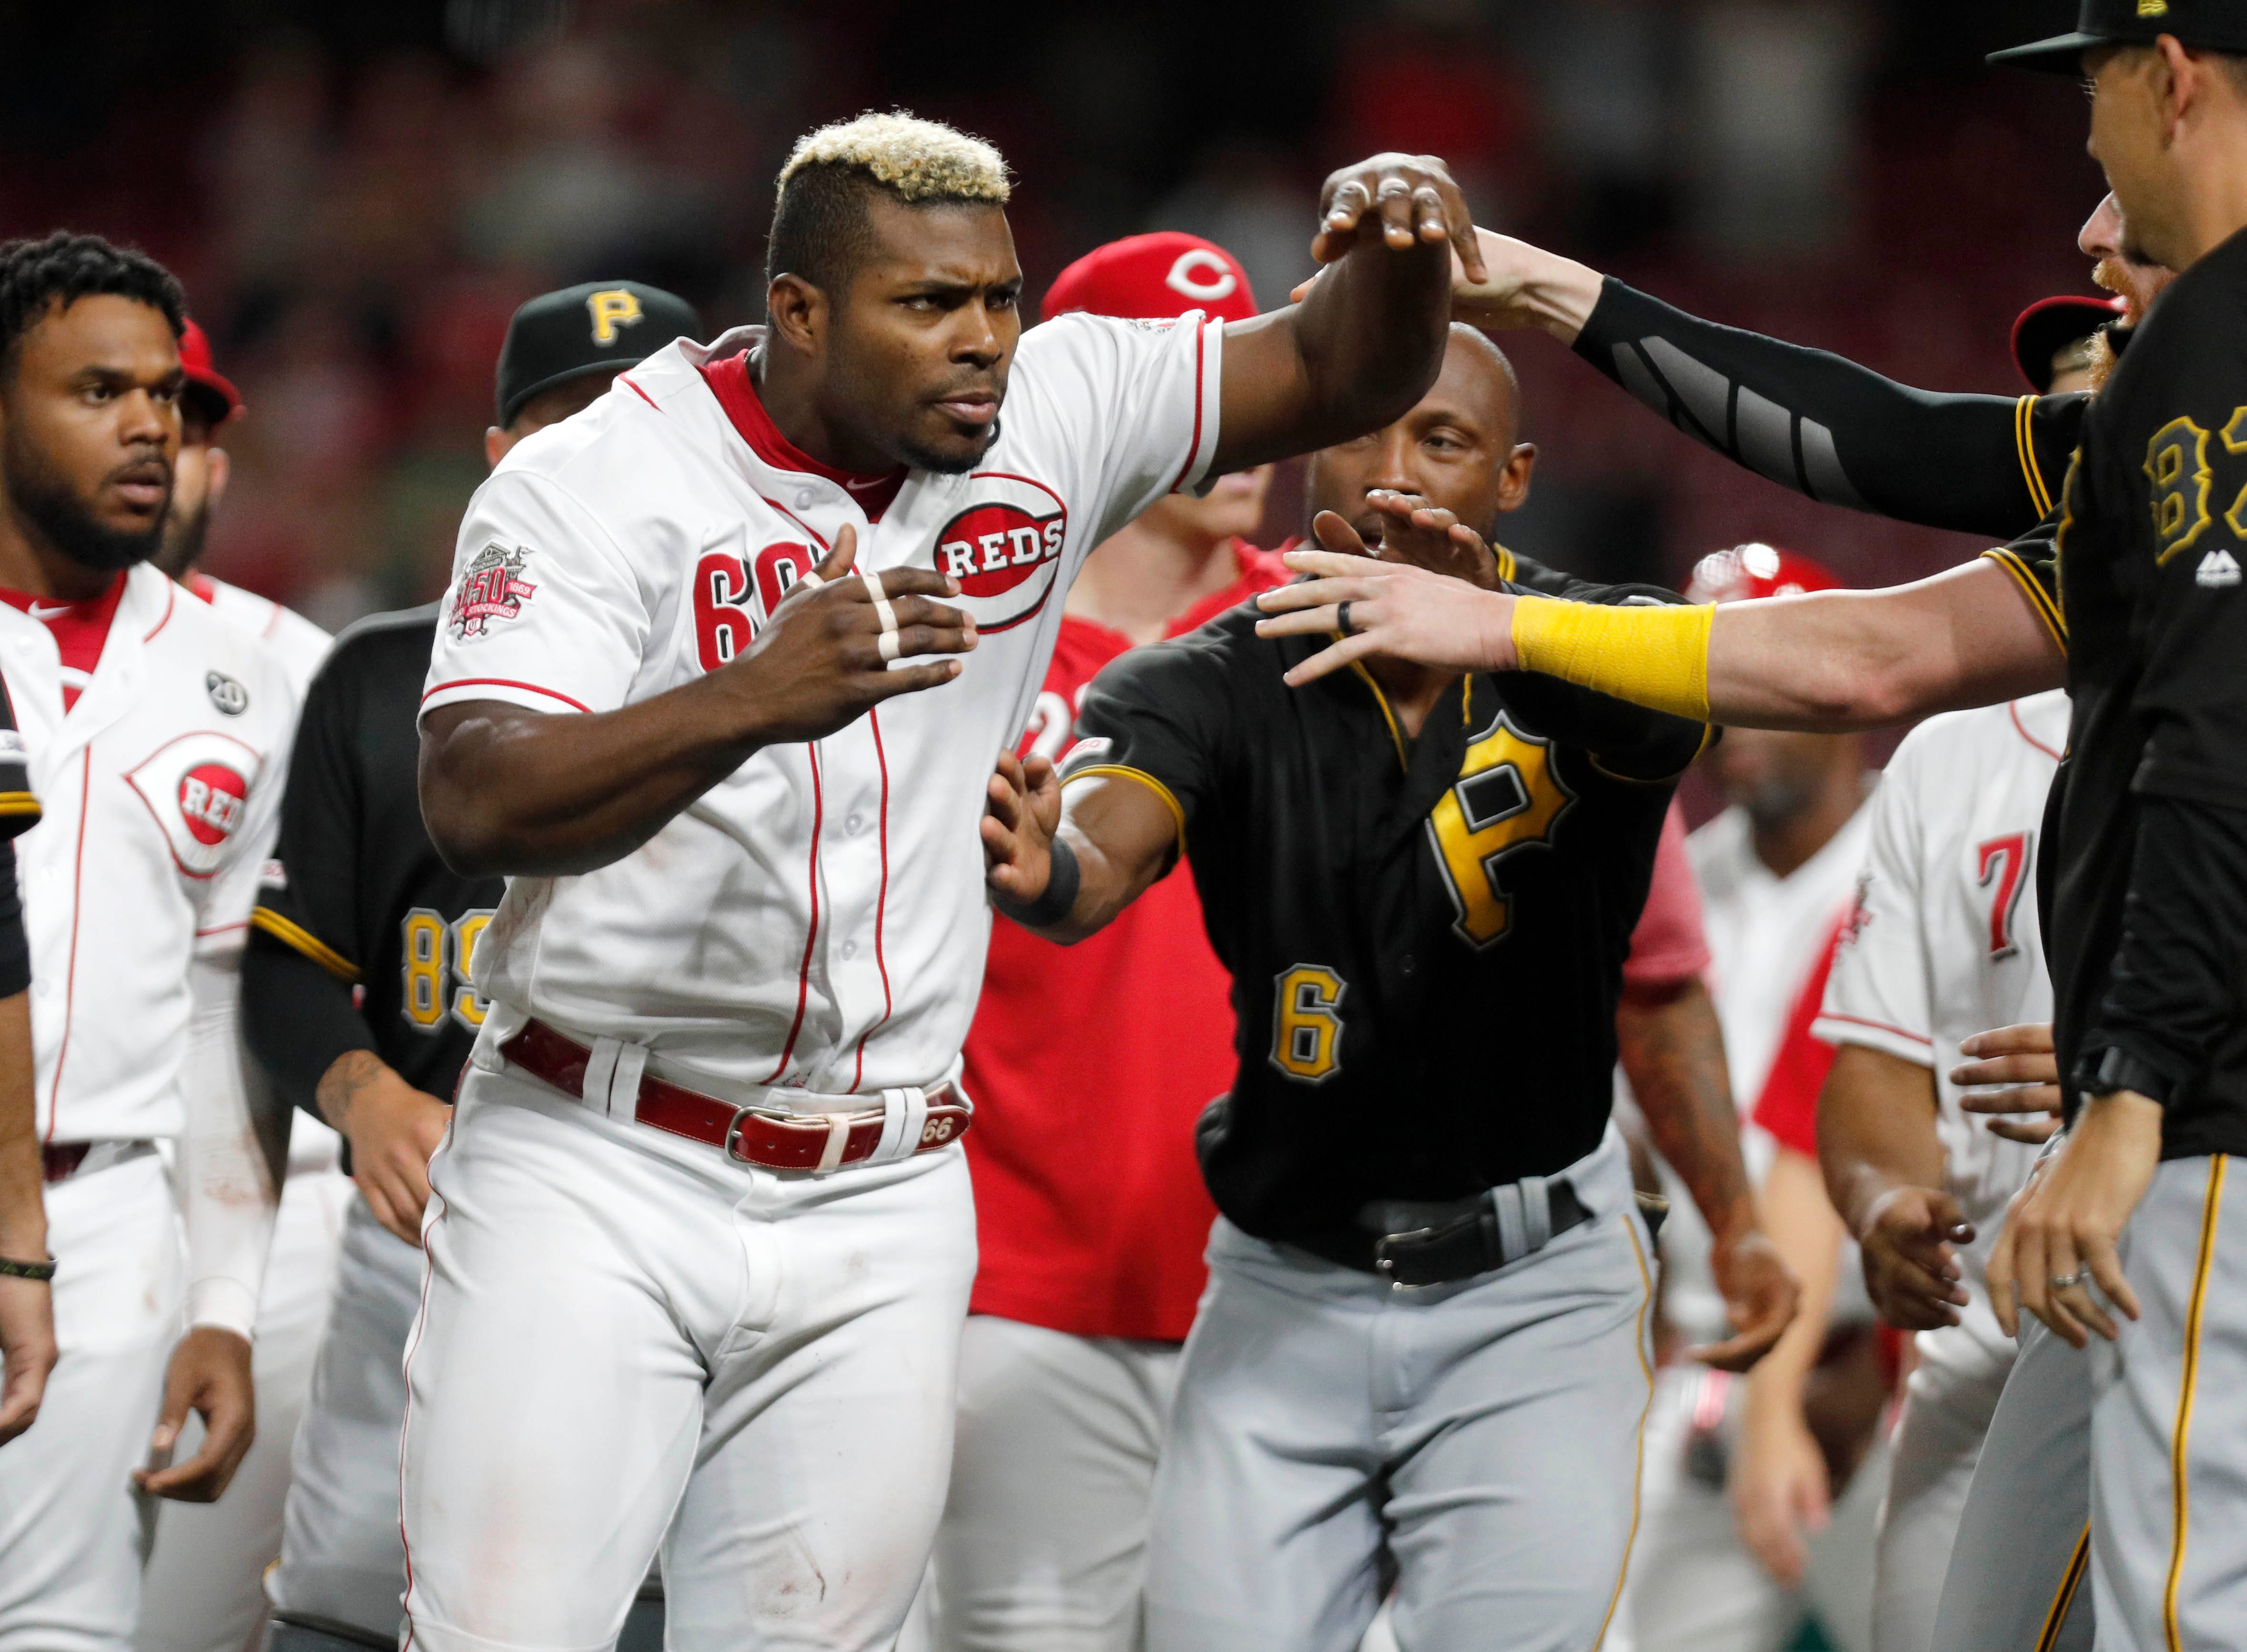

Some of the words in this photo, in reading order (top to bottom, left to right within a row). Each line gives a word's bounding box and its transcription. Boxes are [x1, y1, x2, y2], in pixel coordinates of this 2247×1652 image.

[1165, 249, 1236, 301] C
[586, 288, 643, 348] P
[940, 518, 1064, 578] REDS
[460, 567, 506, 607] 150
[468, 603, 516, 616] STOCKINGS
[509, 581, 531, 594] 1869
[1425, 709, 1579, 952] P
[1977, 829, 2034, 965] 7
[1268, 961, 1347, 1087] 6
[921, 1117, 953, 1142] 66
